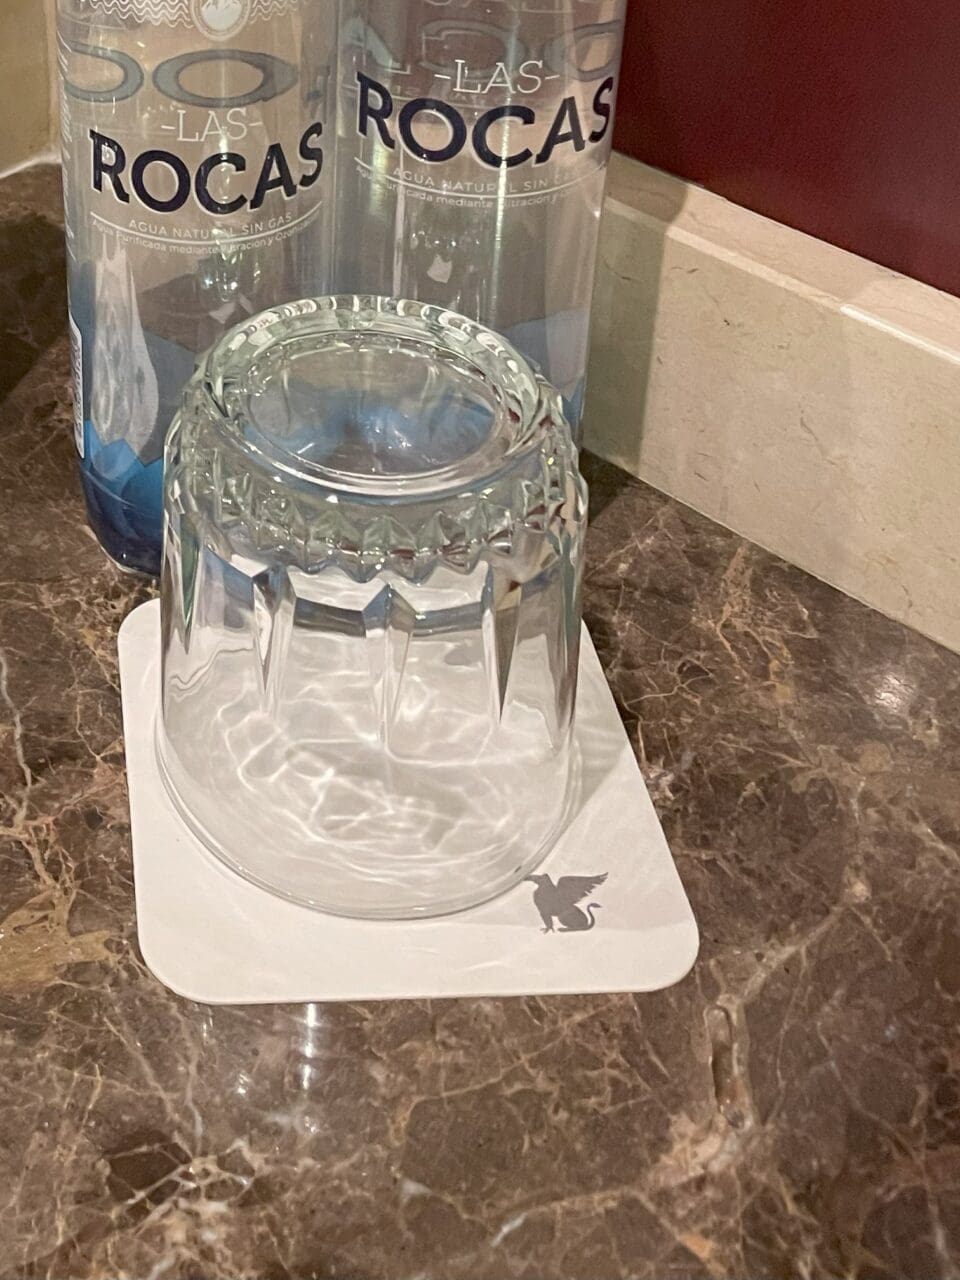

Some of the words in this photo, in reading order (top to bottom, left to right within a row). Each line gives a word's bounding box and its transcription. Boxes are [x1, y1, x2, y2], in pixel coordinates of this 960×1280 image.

[356, 71, 614, 169] ROCAS
[89, 121, 323, 214] ROCAS
[393, 167, 435, 186] AGUA
[441, 178, 517, 194] NATURL
[523, 177, 548, 192] SIN
[129, 219, 168, 236] AGUA
[173, 226, 236, 240] NATUAL
[242, 223, 264, 236] SIN
[268, 212, 293, 229] GAS
[116, 230, 167, 252] Purificada
